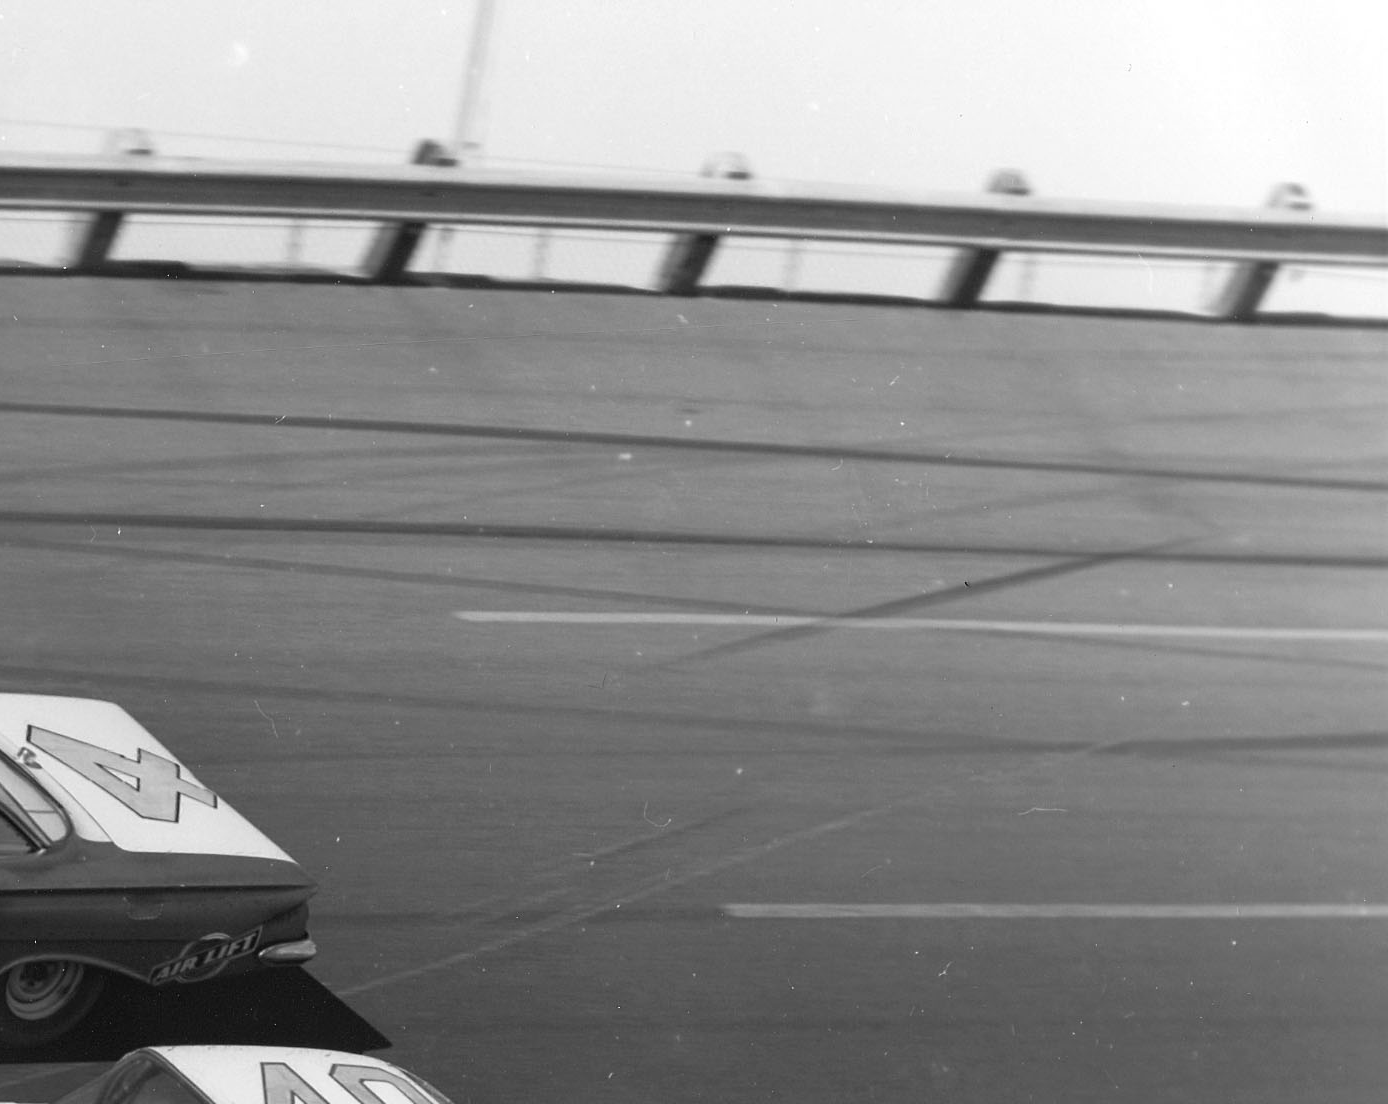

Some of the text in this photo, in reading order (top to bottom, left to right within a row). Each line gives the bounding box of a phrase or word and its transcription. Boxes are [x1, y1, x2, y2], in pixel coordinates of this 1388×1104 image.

[26, 724, 218, 823] 4
[155, 931, 258, 981] AIR LIFT
